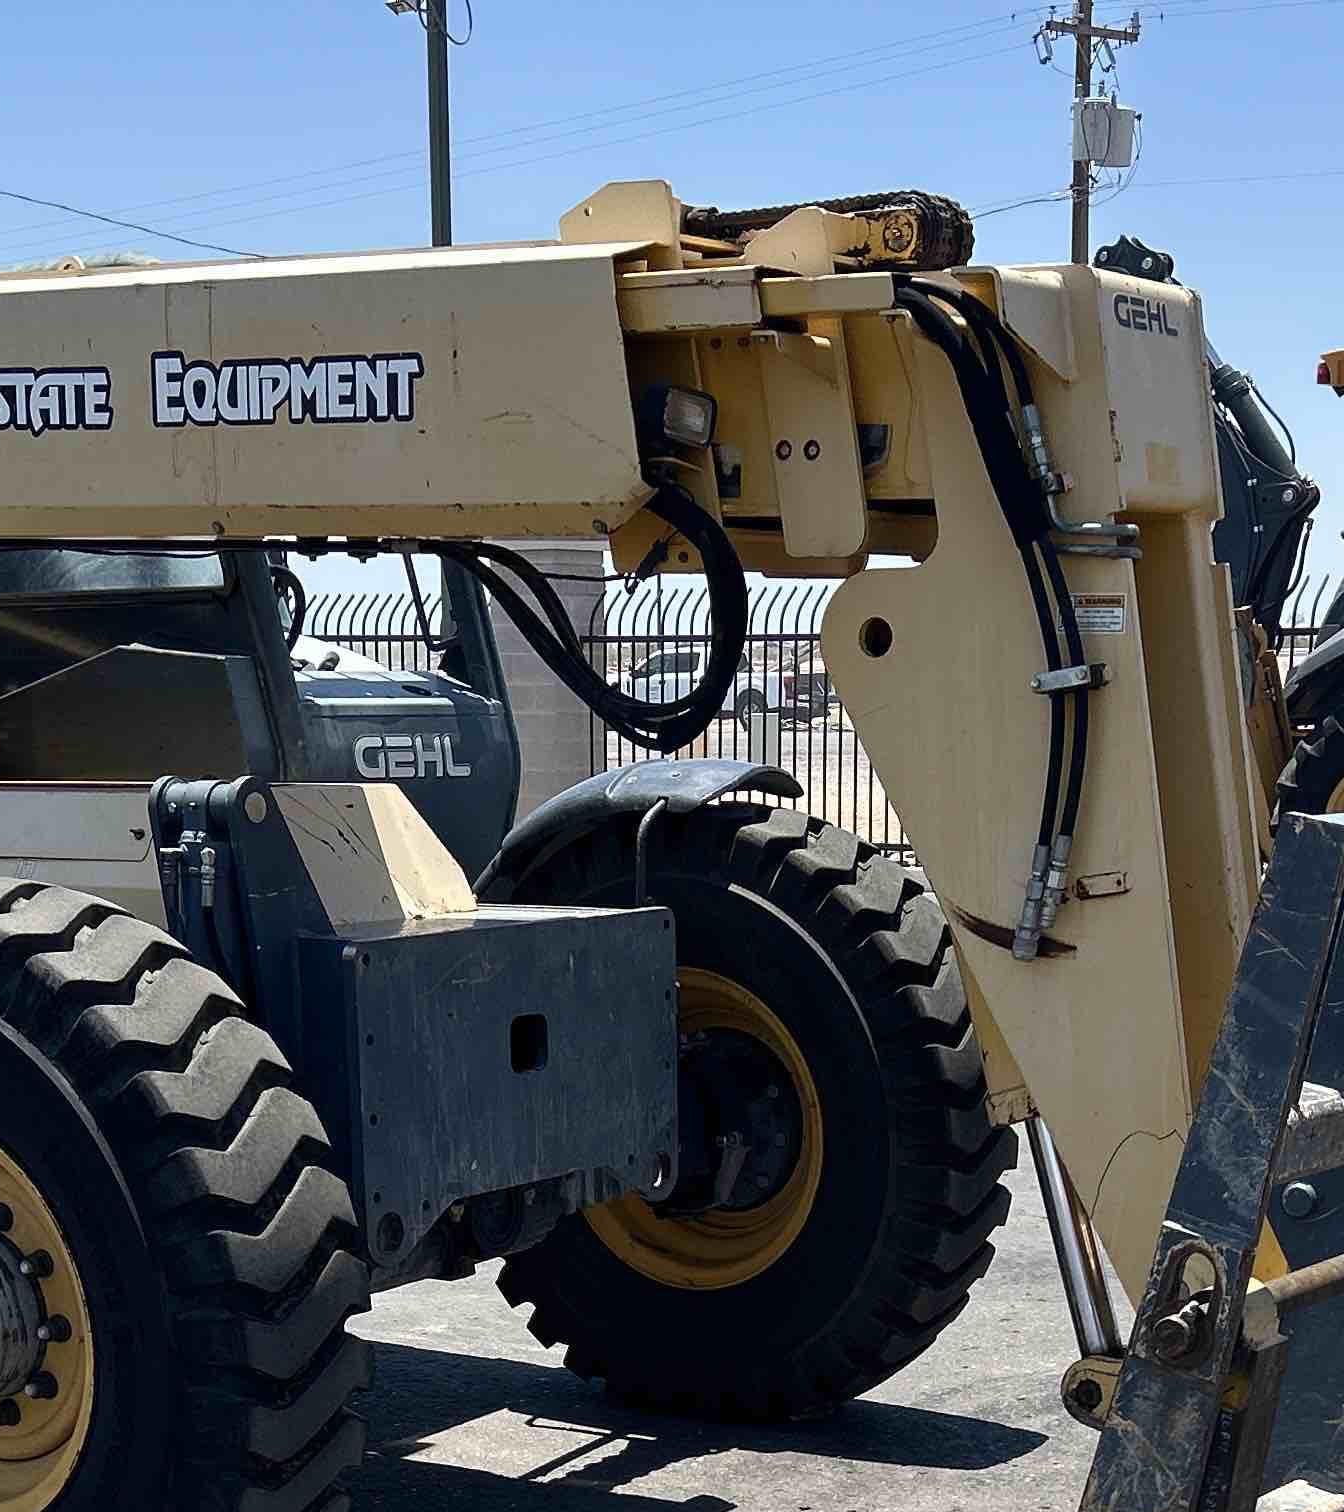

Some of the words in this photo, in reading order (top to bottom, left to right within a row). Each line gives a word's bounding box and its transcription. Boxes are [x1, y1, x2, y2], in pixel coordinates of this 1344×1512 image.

[1113, 293, 1179, 337] GEHL
[152, 351, 424, 427] EQUIPMENT
[353, 734, 472, 779] GEHL
